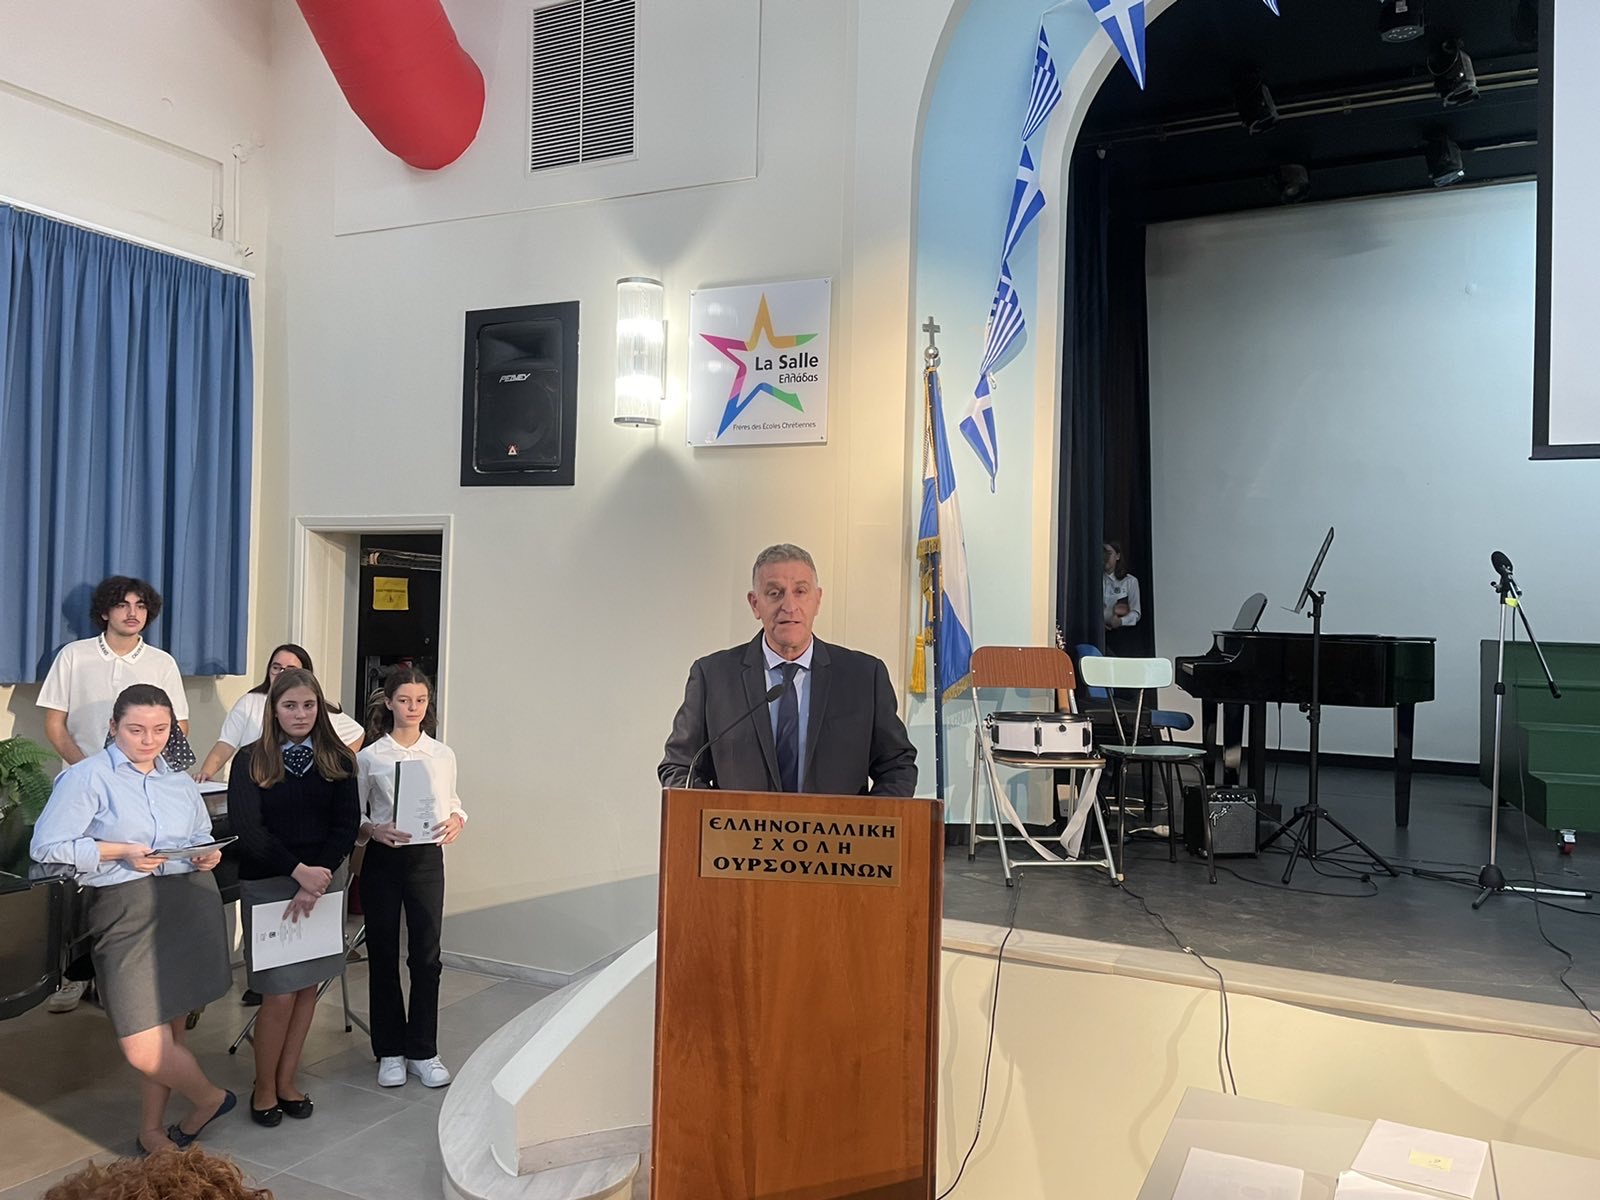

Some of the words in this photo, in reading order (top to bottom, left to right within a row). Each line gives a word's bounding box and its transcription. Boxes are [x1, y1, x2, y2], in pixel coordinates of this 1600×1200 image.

[755, 356, 773, 371] La
[779, 352, 819, 370] Salle
[779, 372, 819, 384] Ελλάδας
[709, 816, 896, 839] ΕΛΛΗΝΟΓΑΛΛΙΚΗ
[713, 855, 894, 879] ΟΥΡΣΟΥΛΙΝΩΝ
